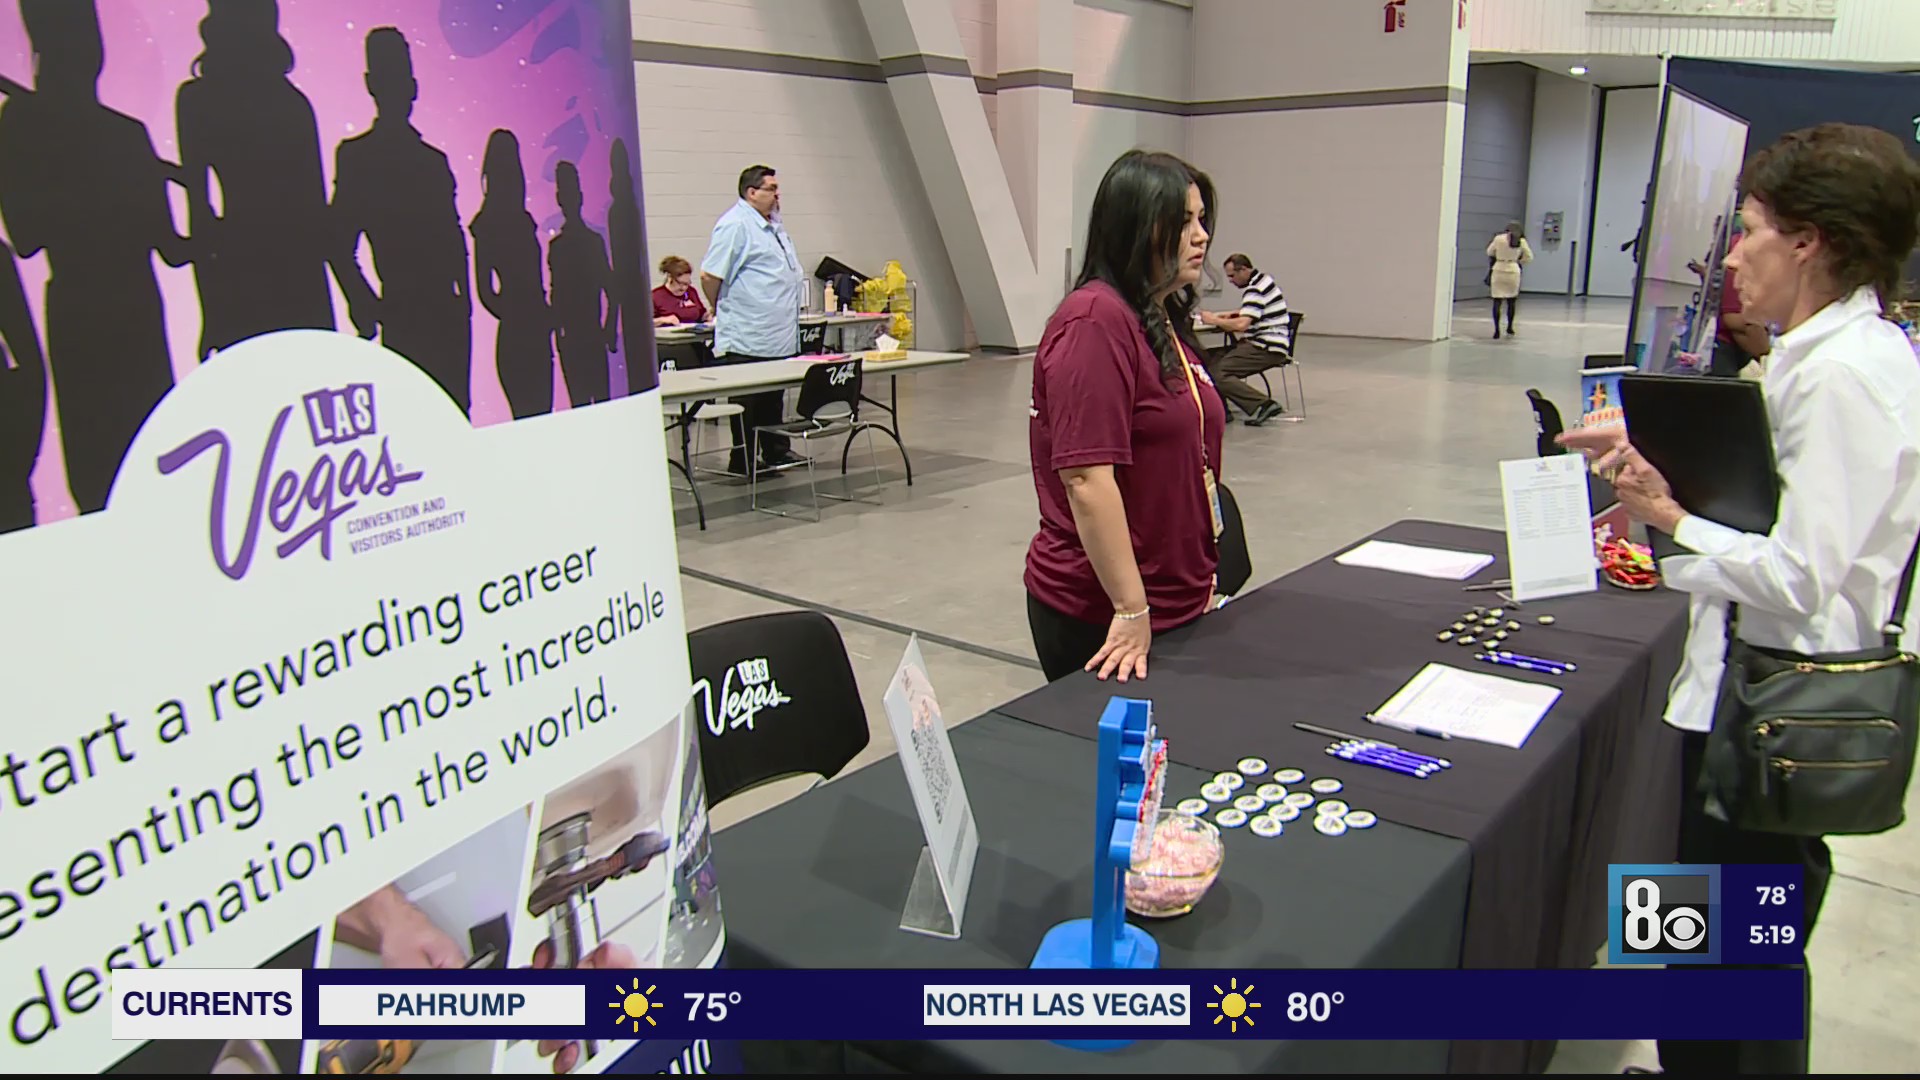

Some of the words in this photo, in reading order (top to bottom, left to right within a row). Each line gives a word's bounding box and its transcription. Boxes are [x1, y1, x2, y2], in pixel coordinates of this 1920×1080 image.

[304, 384, 376, 445] LAS
[157, 404, 424, 581] Vegas
[347, 504, 419, 534] CONVENTION
[422, 497, 446, 513] AND
[351, 528, 403, 554] VISITORS
[406, 511, 465, 538] AUTHORITY
[0, 713, 135, 808] tart
[157, 699, 190, 744] a
[210, 594, 464, 722] rewarding
[479, 546, 598, 614] career
[277, 724, 363, 787] the
[379, 682, 490, 742] most
[502, 583, 664, 686] incredible
[692, 667, 791, 736] Vegas
[738, 659, 769, 685] LAS
[360, 792, 404, 839] in
[415, 752, 488, 808] the
[500, 676, 618, 765] world.
